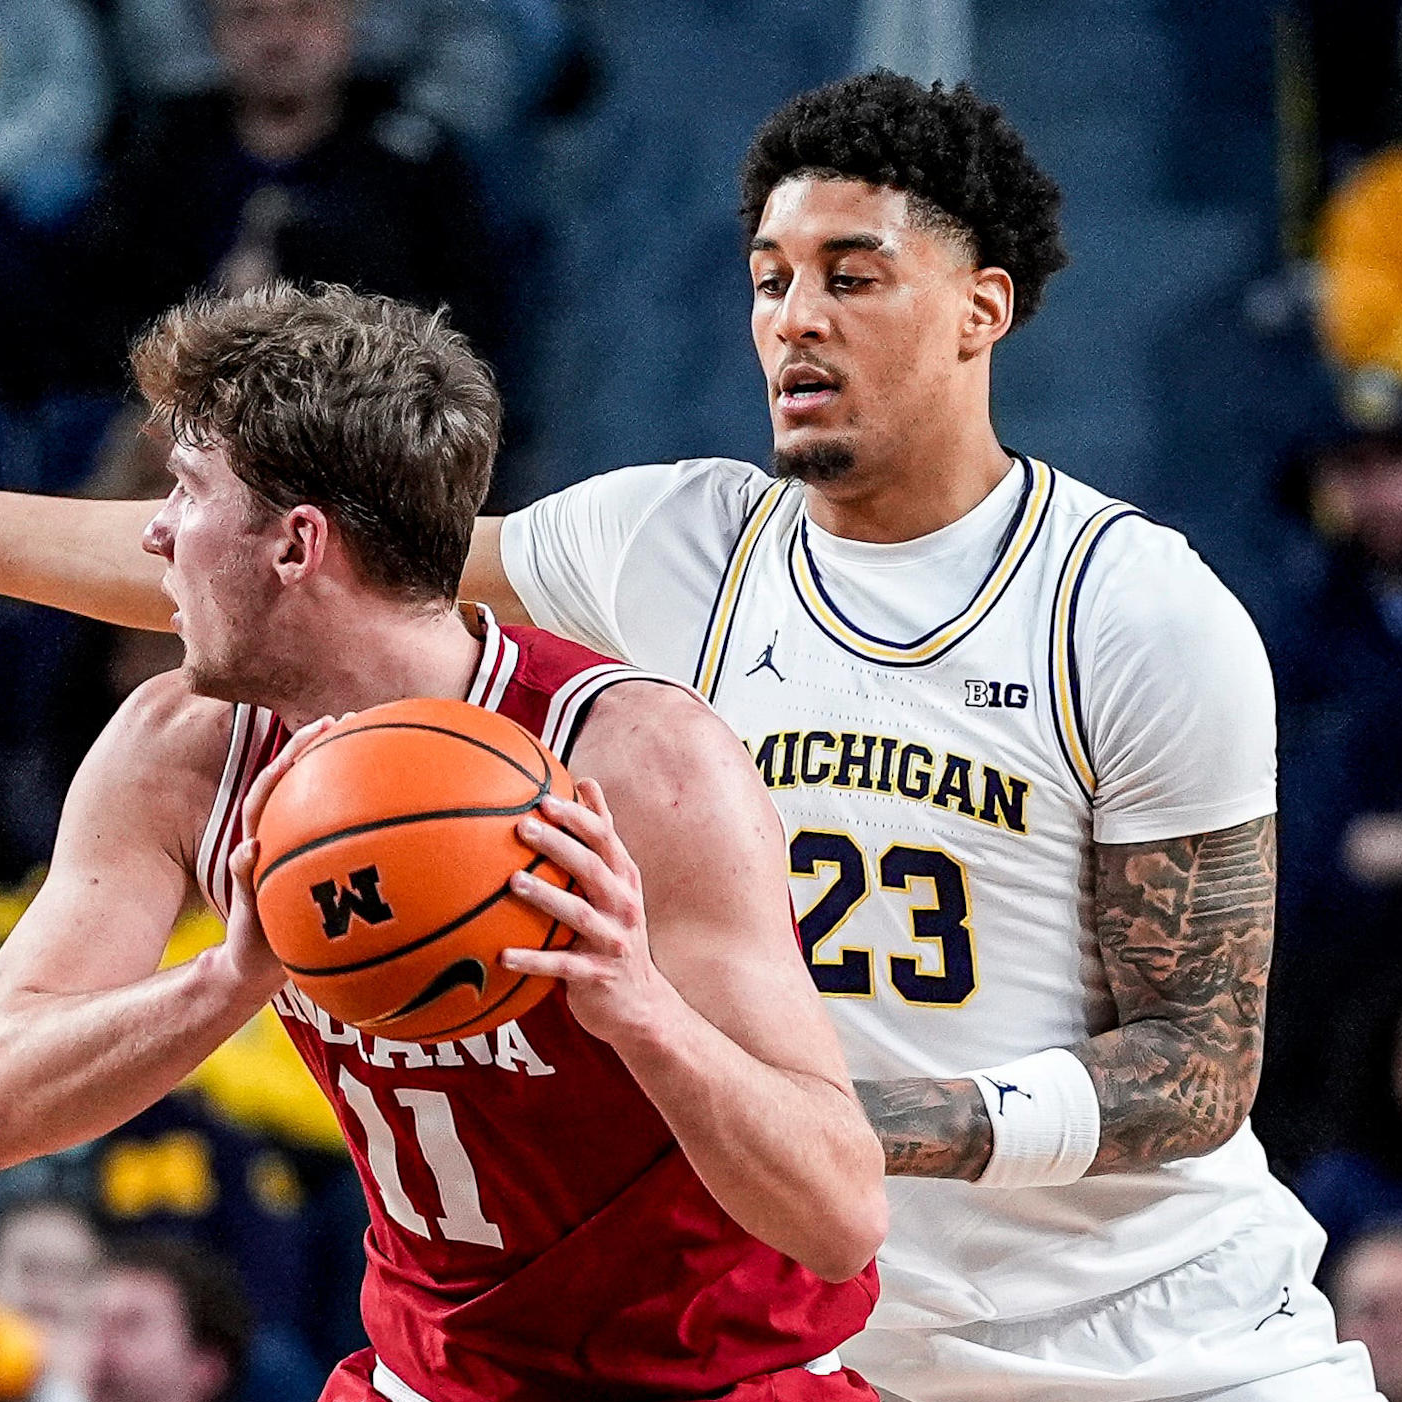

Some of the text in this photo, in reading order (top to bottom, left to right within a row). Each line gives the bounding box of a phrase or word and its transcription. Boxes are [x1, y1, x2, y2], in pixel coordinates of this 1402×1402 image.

[741, 730, 1031, 835] MICHIGAN
[790, 827, 980, 1009] 23
[338, 1064, 504, 1250] 11
